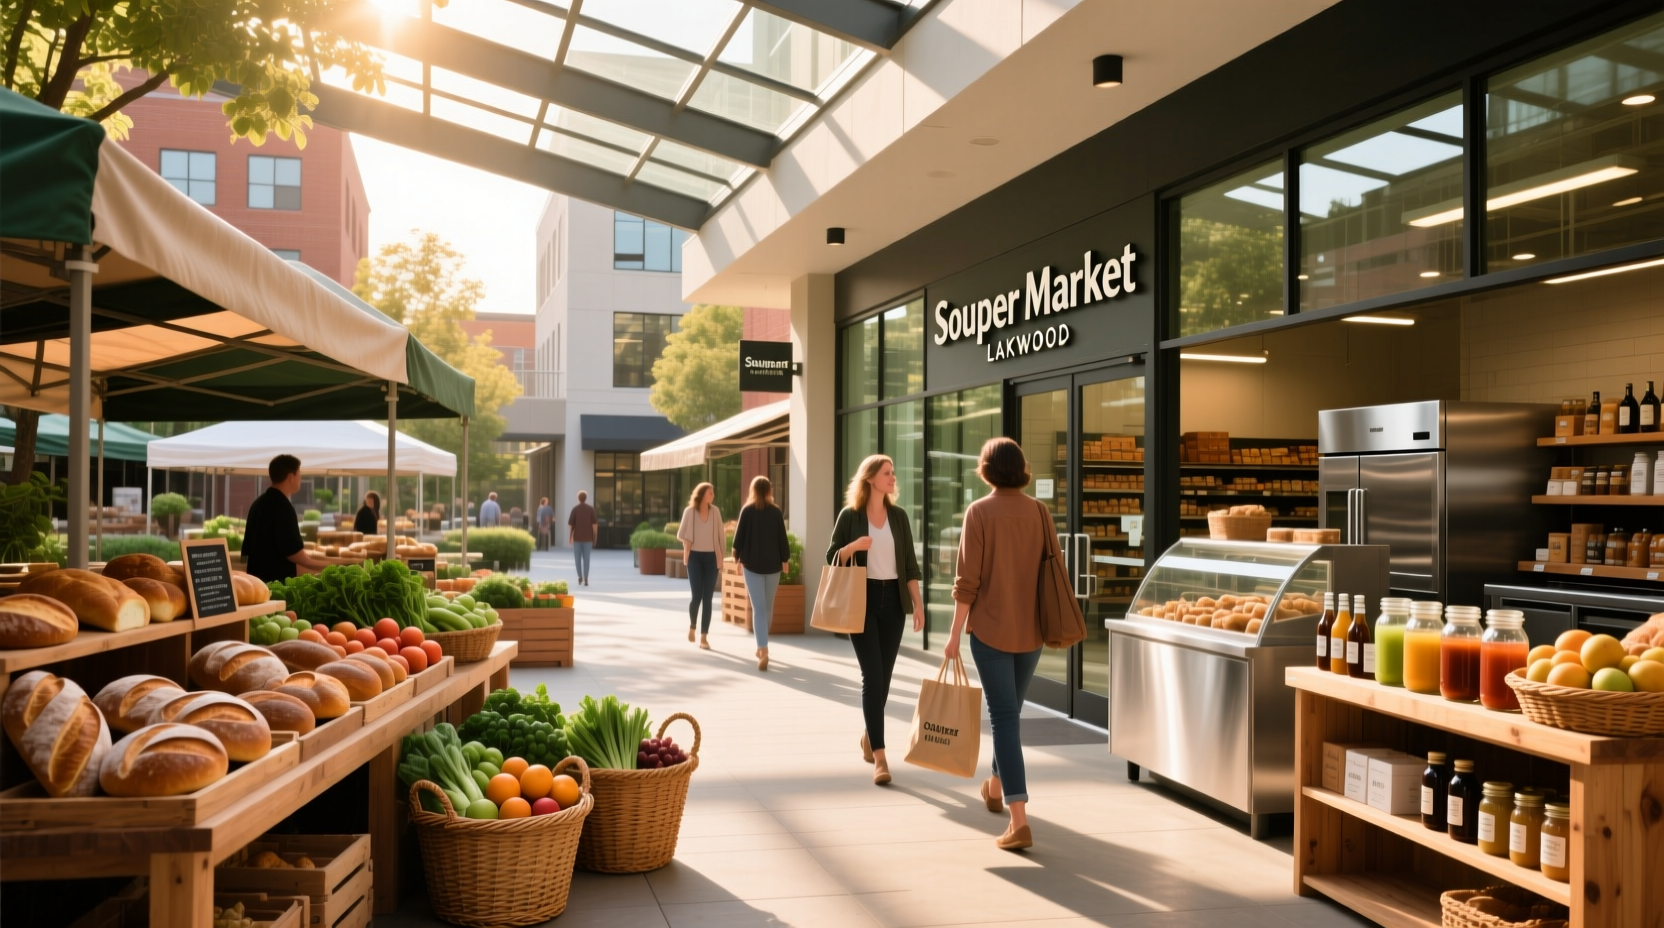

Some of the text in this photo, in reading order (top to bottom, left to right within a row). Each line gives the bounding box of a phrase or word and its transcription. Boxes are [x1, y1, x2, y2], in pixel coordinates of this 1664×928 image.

[934, 243, 1136, 346] Souper Market
[987, 323, 1070, 362] LAKWOOD
